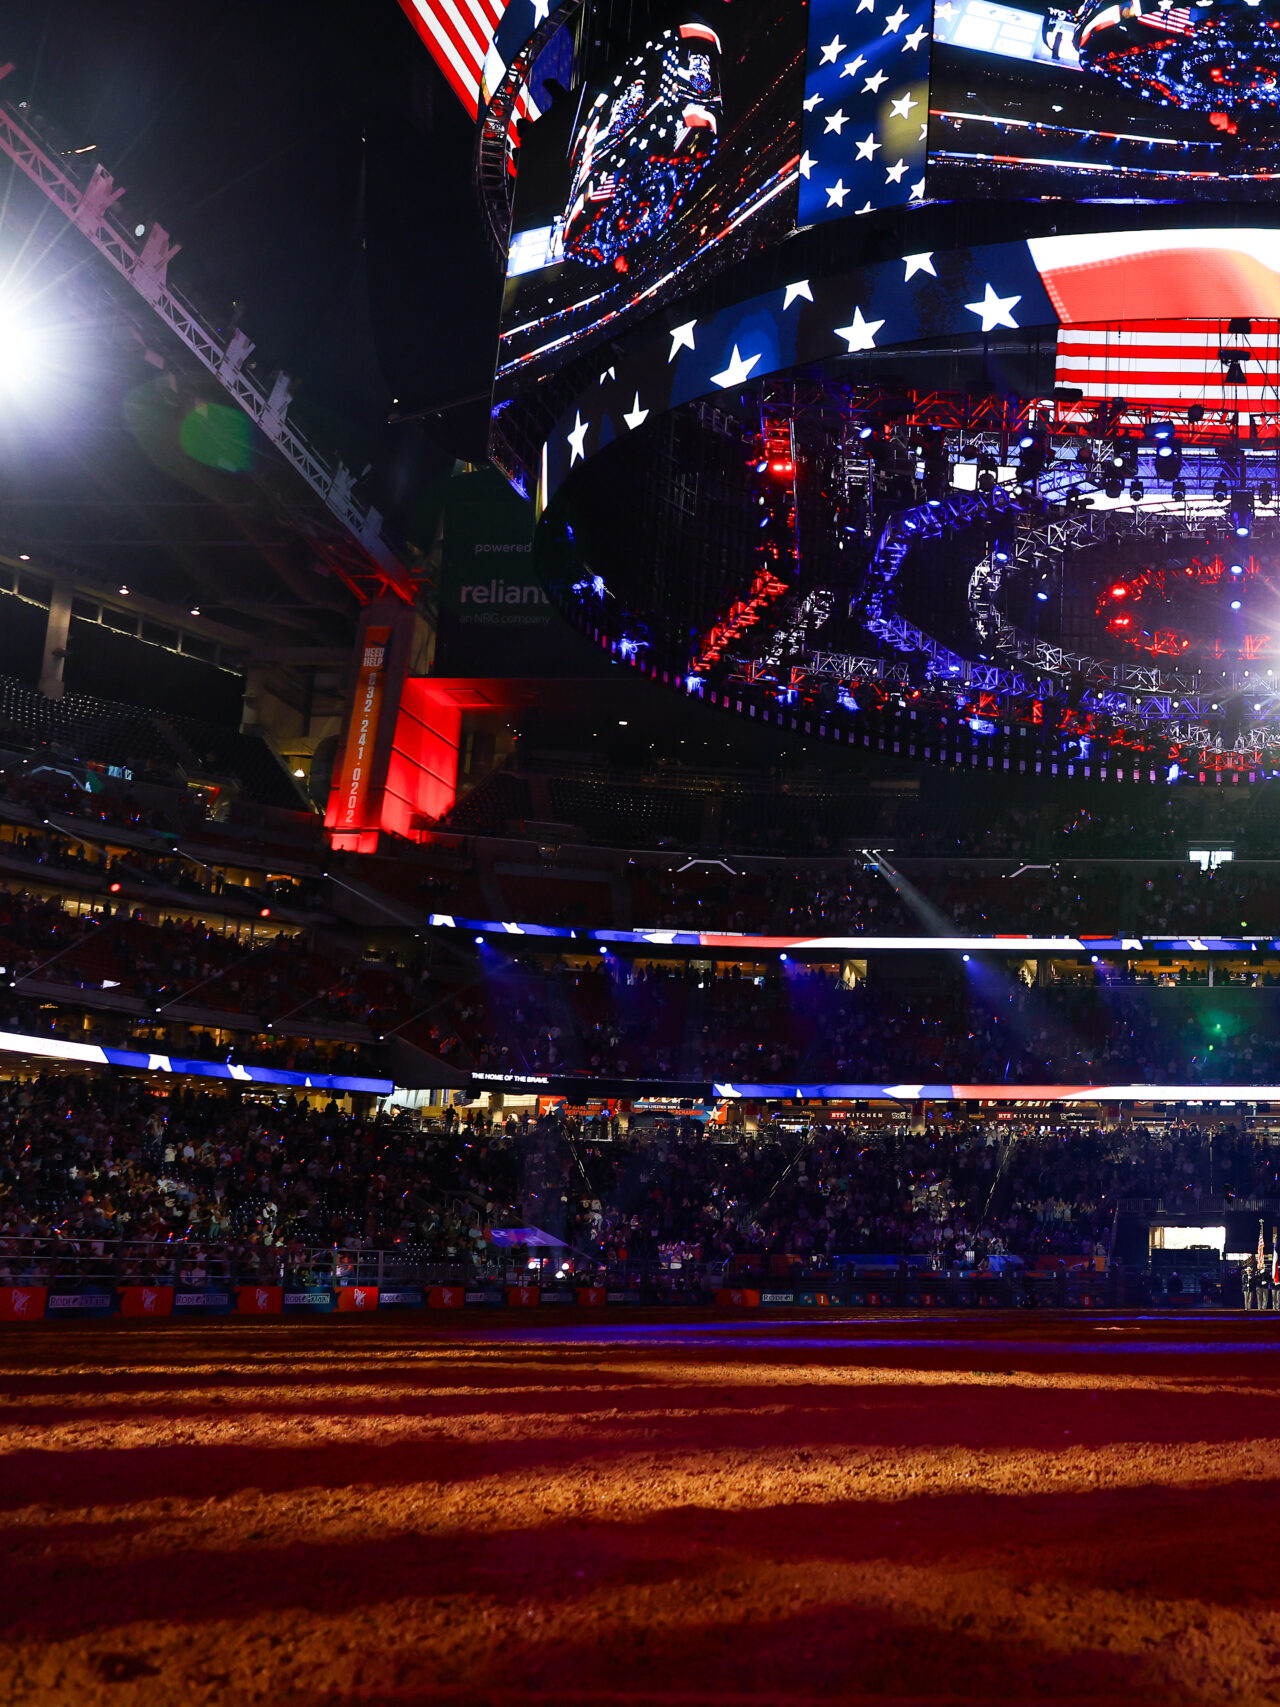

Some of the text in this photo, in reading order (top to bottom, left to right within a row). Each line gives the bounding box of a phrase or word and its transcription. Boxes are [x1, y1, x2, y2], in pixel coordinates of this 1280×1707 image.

[474, 541, 533, 556] powered
[474, 613, 499, 625] NRG
[500, 615, 551, 626] company
[364, 647, 385, 658] NEED
[363, 657, 384, 668] HELP
[472, 1072, 484, 1080] THE
[485, 1073, 504, 1081] HOME
[514, 1075, 527, 1083] THE
